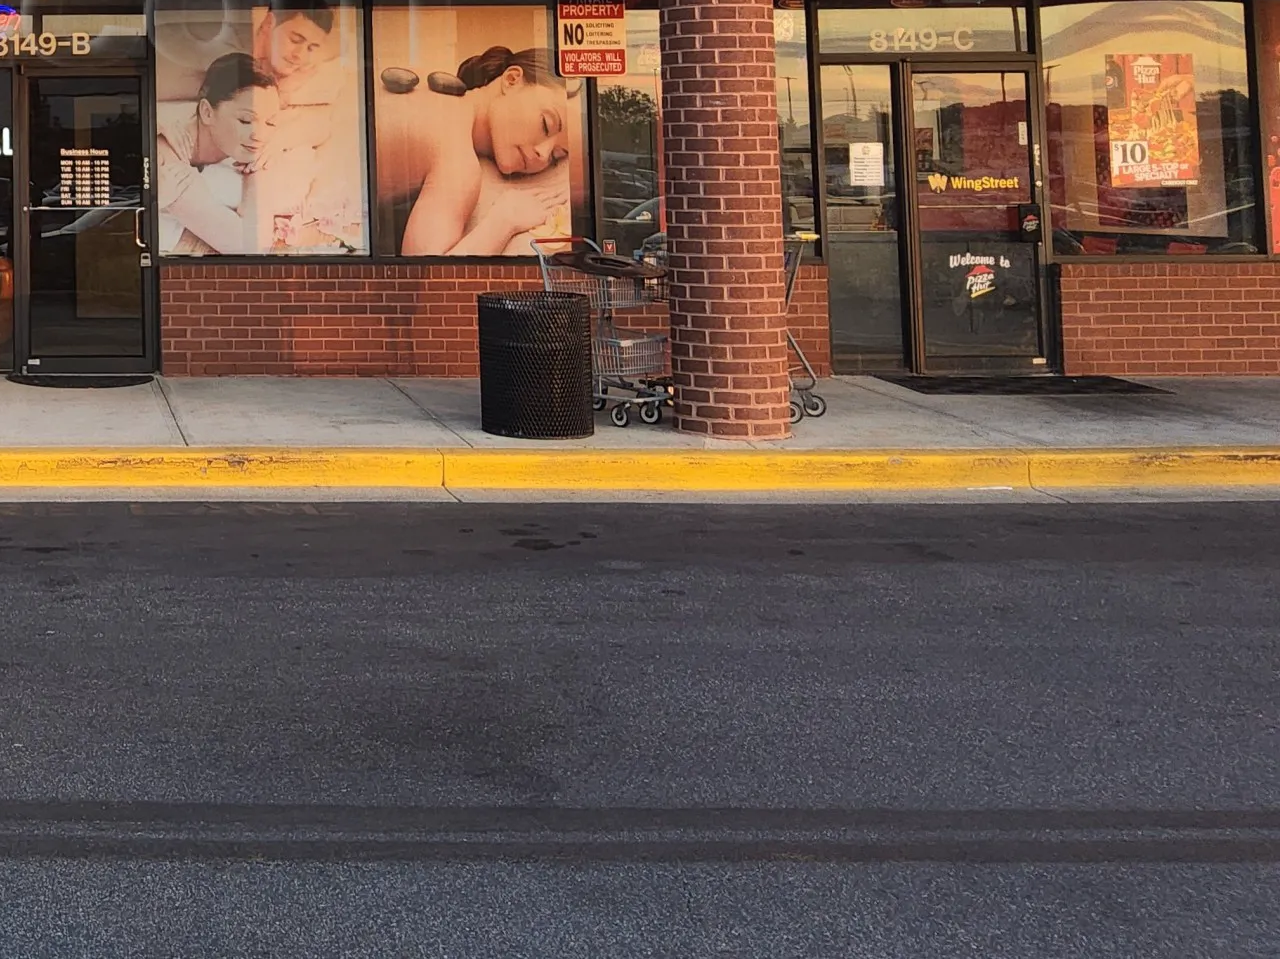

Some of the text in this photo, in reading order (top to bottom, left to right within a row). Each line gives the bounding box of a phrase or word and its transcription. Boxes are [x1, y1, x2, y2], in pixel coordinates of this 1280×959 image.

[562, 4, 620, 17] PROPERTY
[563, 23, 584, 45] NO
[869, 28, 974, 52] 8149-C
[565, 52, 622, 62] VIOLATORS WILL
[565, 62, 622, 72] BE PROSECUTED
[90, 148, 109, 156] Hours
[1114, 143, 1147, 164] $10
[1122, 163, 1151, 175] LARGE
[1134, 170, 1179, 182] SPECIALTY
[950, 176, 1019, 191] WingStreet
[949, 252, 1011, 269] Welcome to
[966, 272, 995, 290] Pizza
[971, 280, 992, 293] Hut
